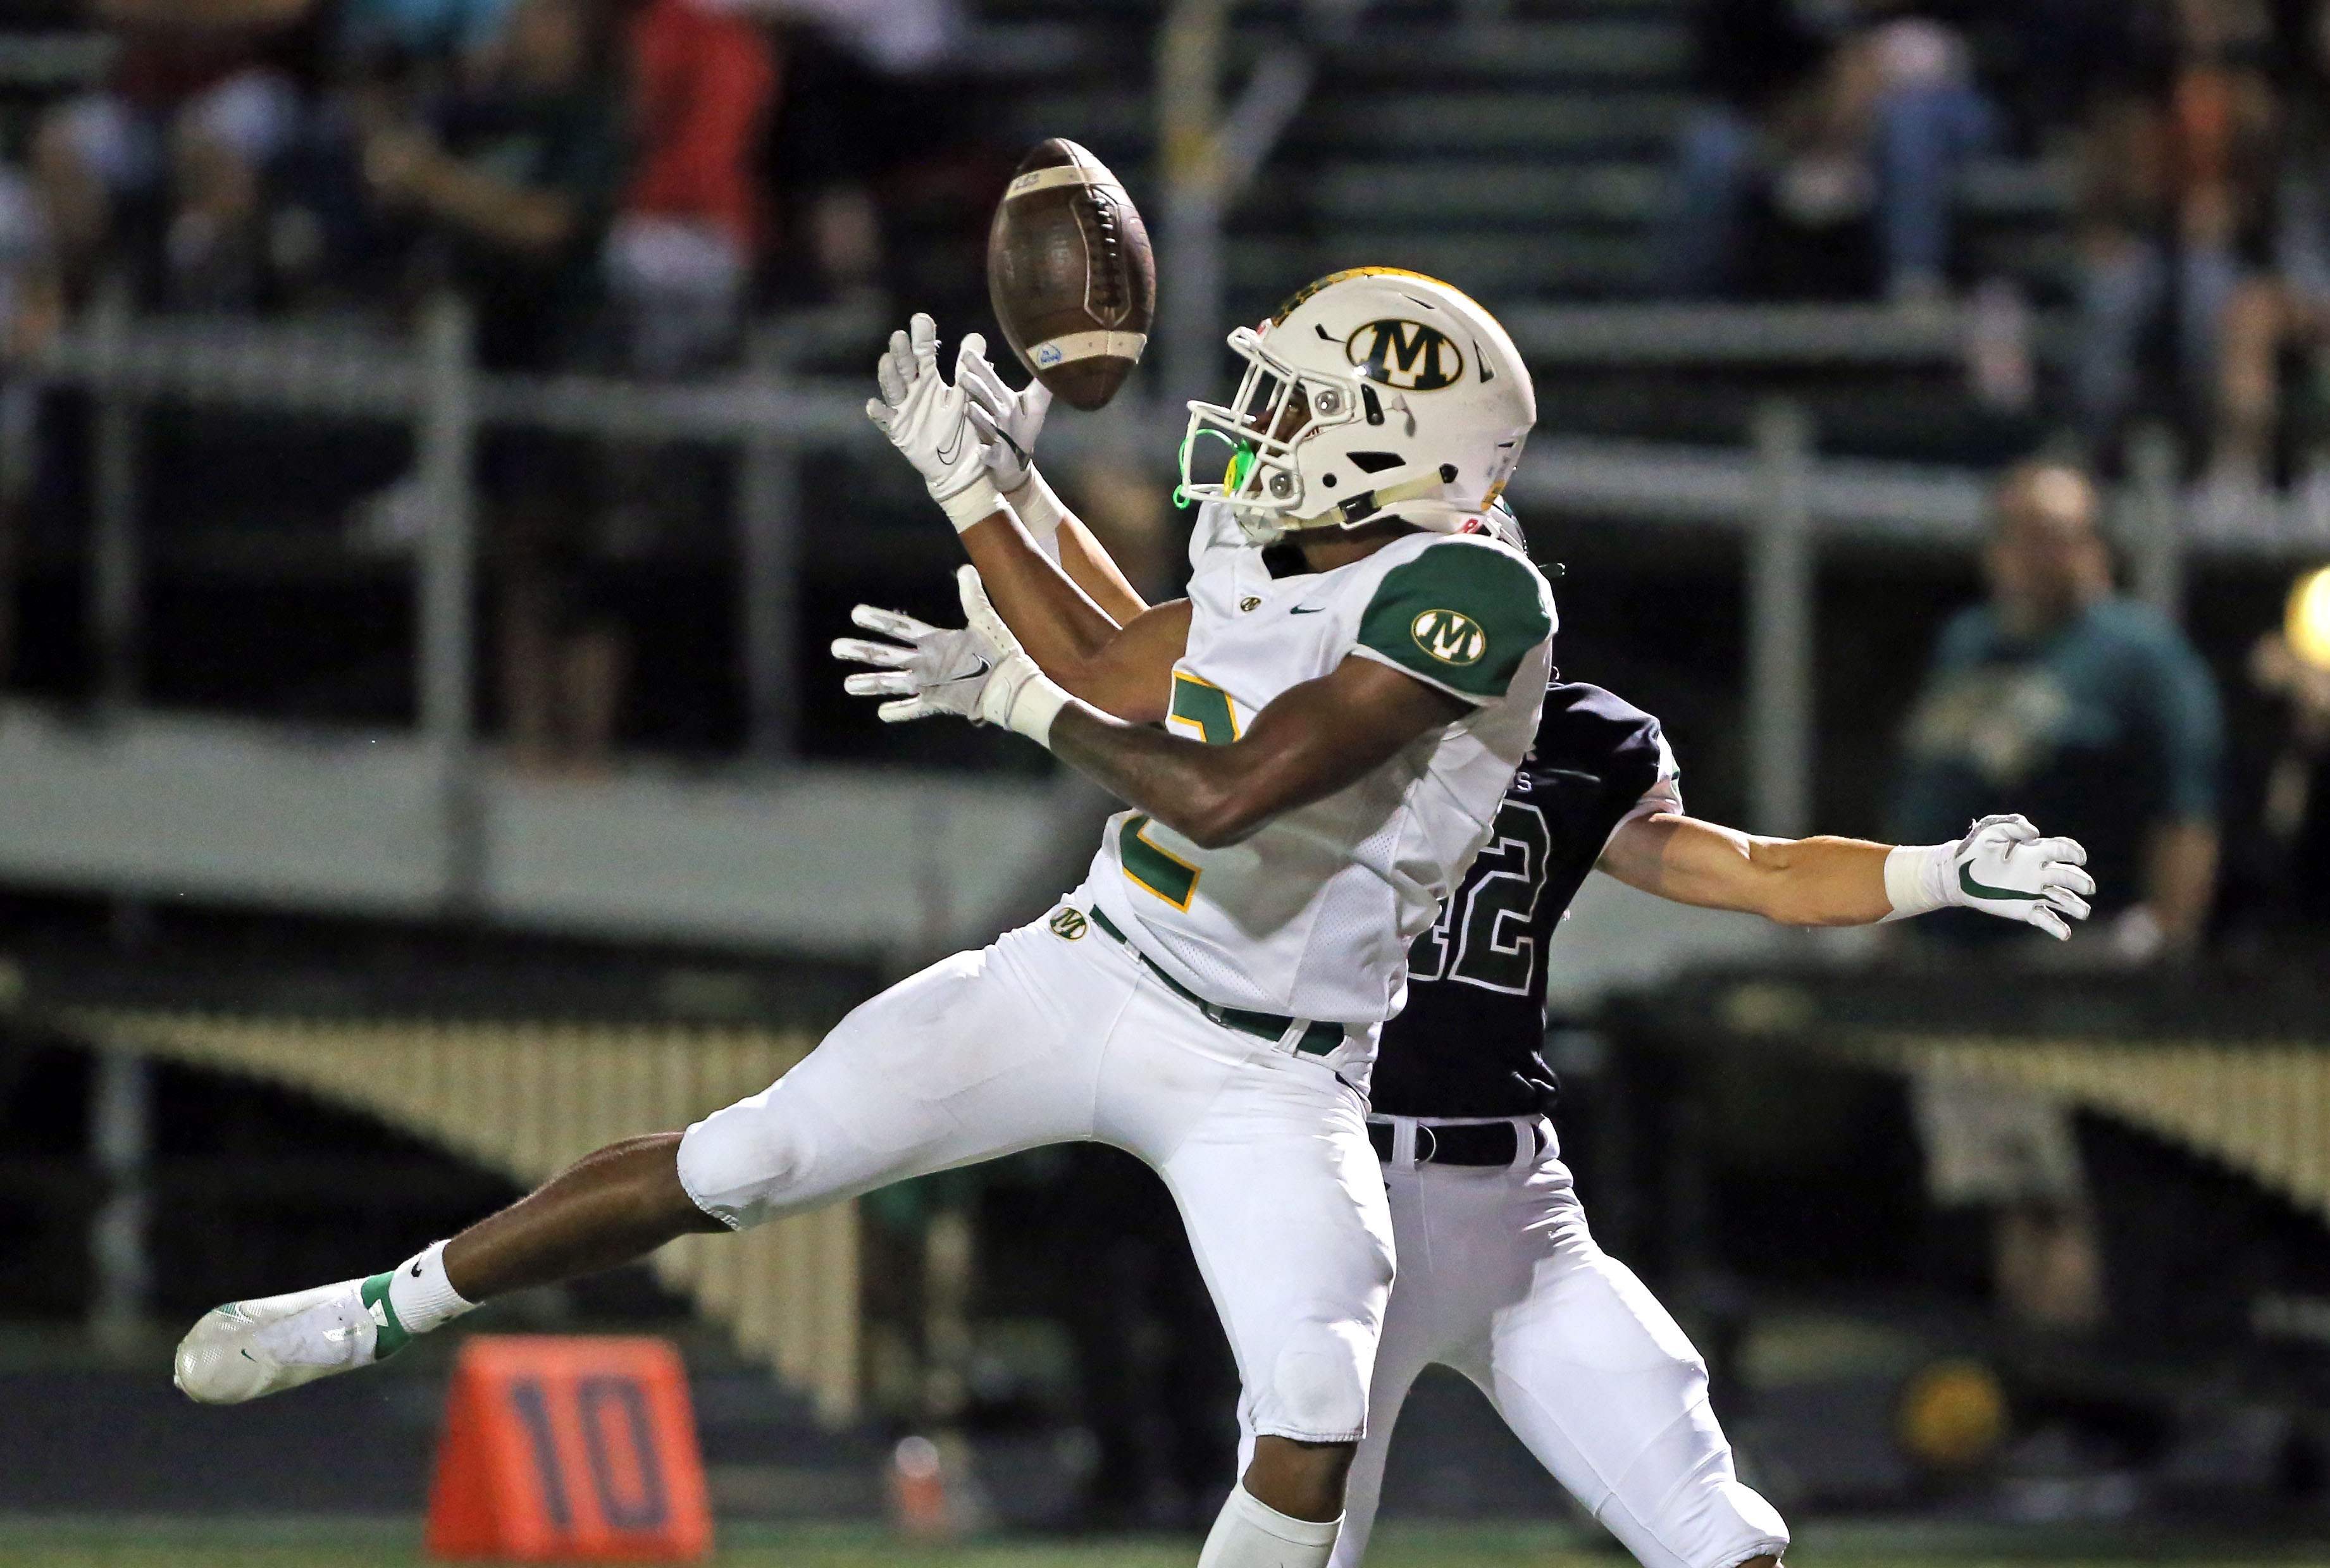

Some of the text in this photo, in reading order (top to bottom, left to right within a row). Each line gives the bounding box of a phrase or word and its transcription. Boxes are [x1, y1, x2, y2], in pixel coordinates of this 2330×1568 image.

[1355, 319, 1449, 390] M
[1415, 610, 1482, 664] M
[1050, 908, 1086, 939] M
[513, 1374, 669, 1531] 10
